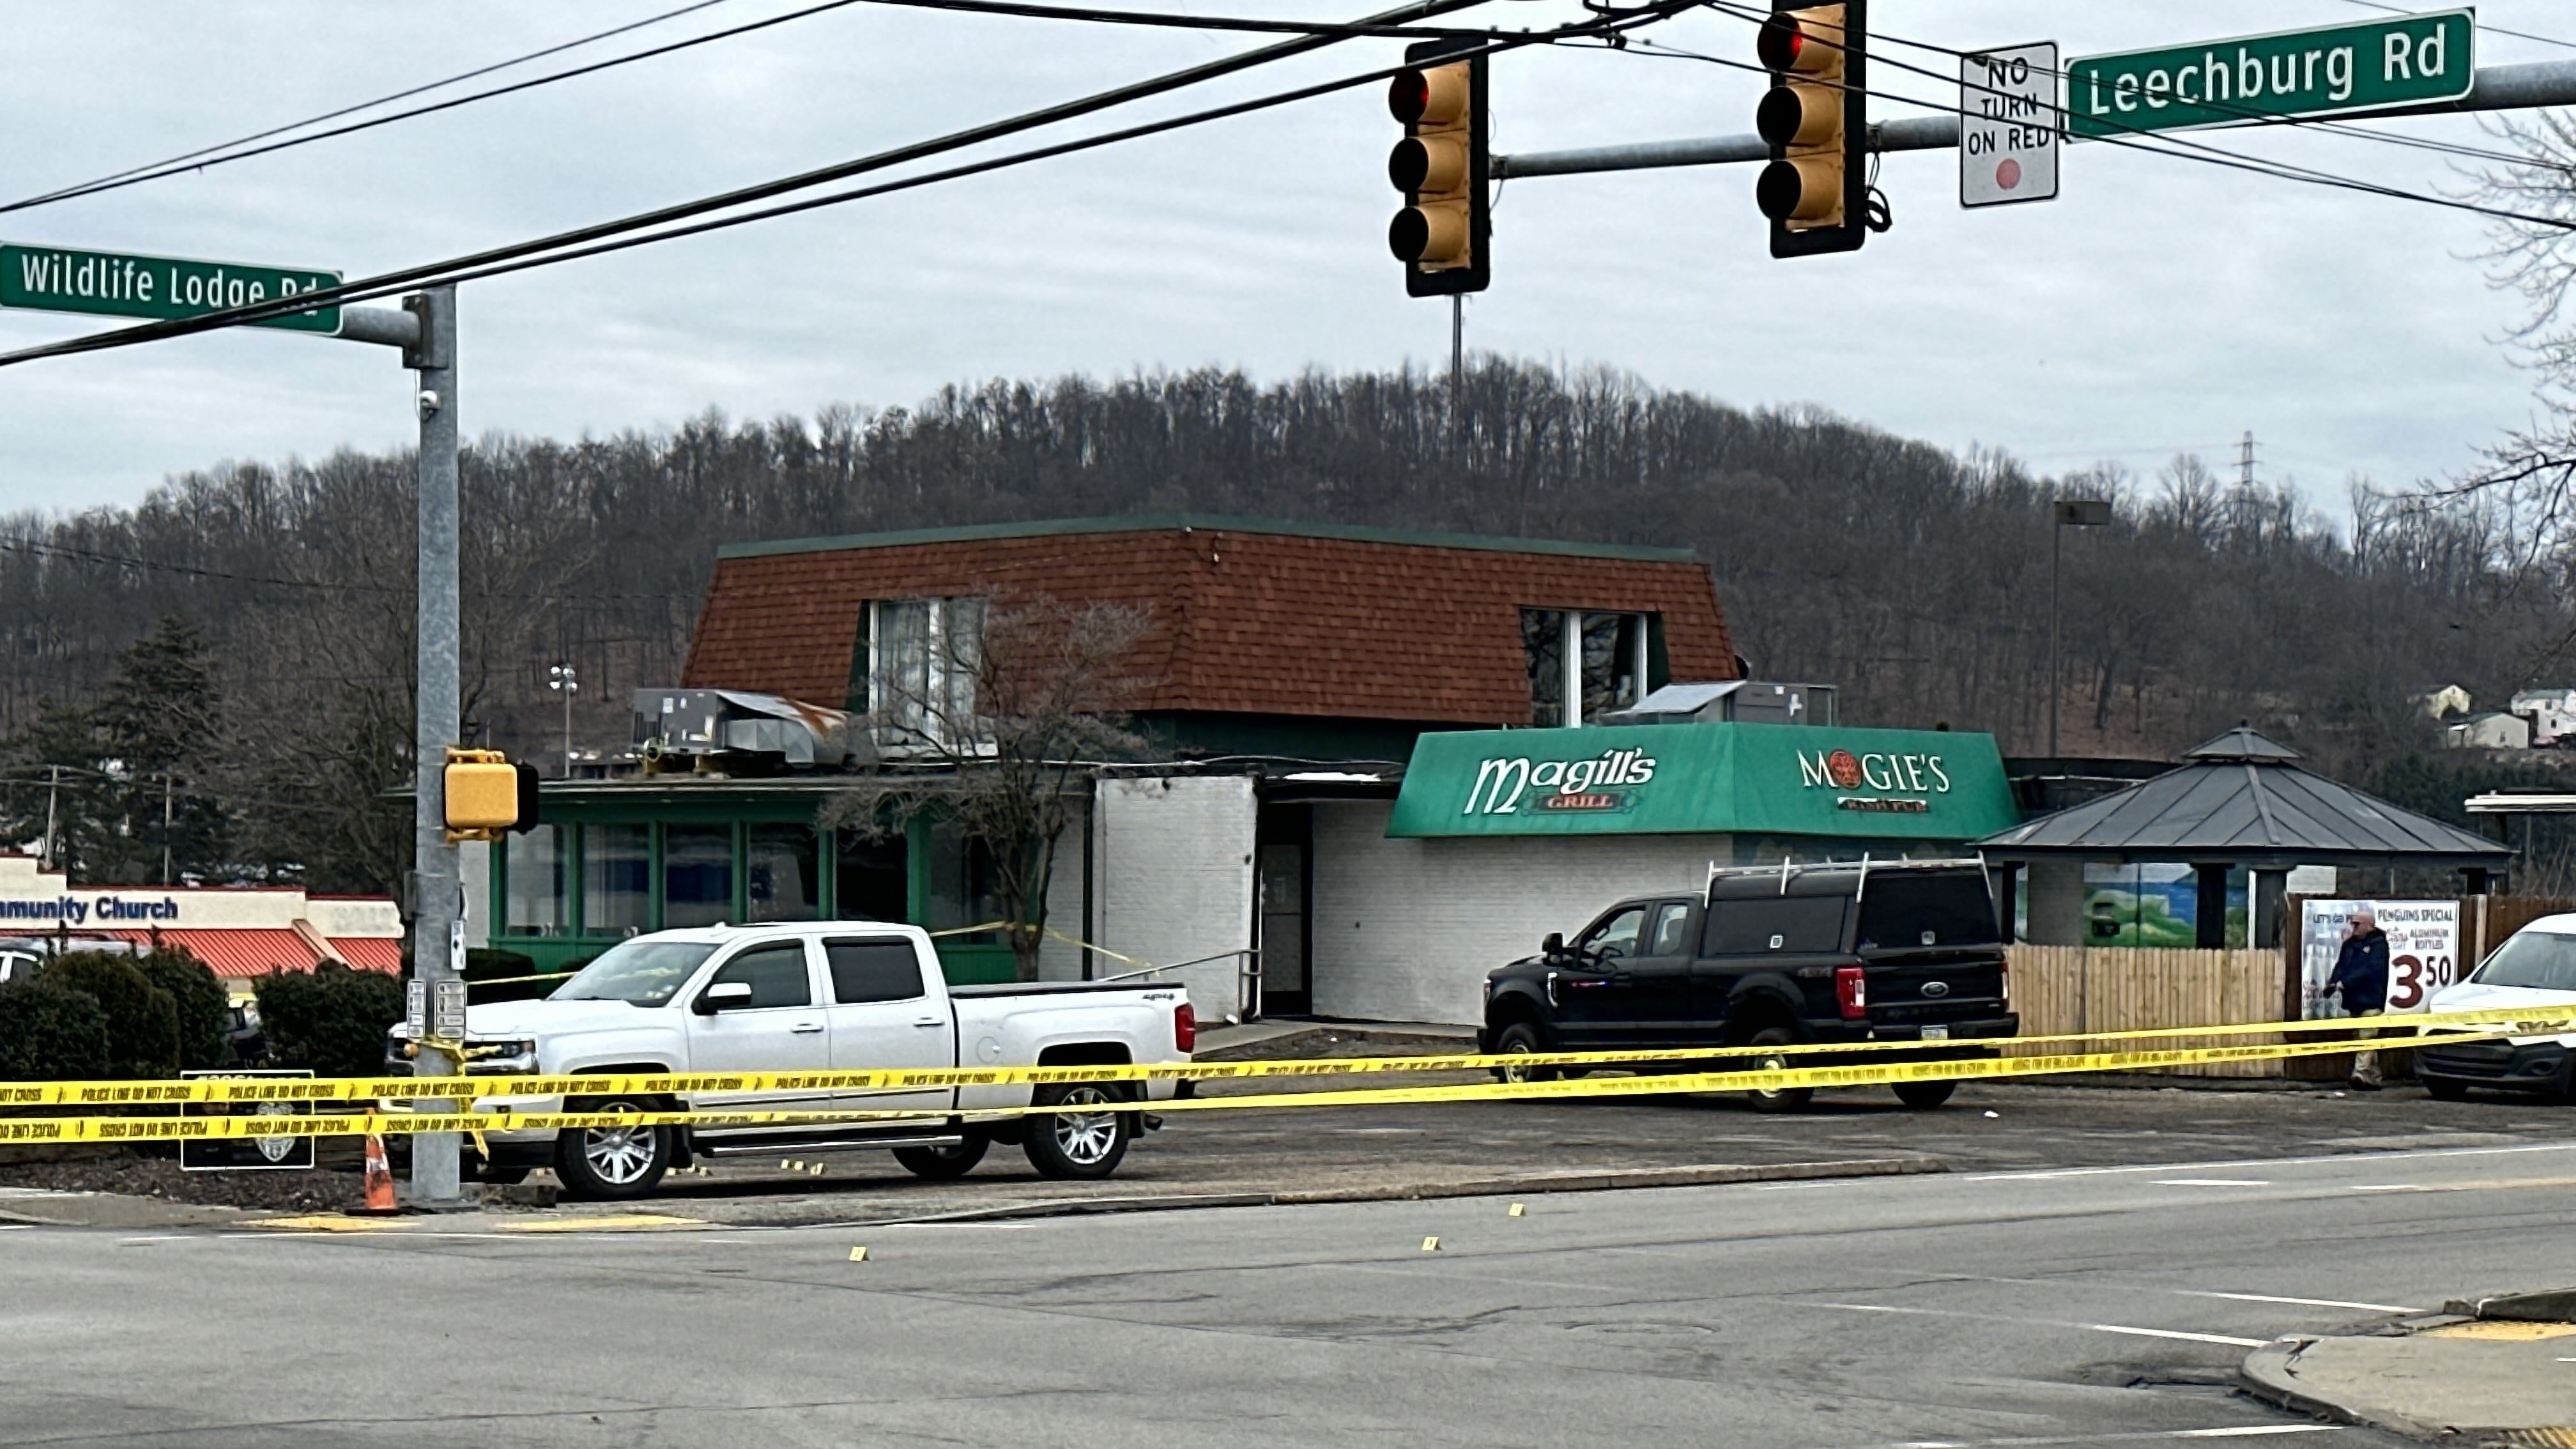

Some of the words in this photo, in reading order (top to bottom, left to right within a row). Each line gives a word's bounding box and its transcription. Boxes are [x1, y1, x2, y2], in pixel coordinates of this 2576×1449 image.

[1989, 57, 2028, 88] NO
[2090, 46, 2354, 116] Leechburg
[2384, 23, 2446, 82] Rd
[1981, 93, 2037, 118] TURN
[1968, 130, 1995, 155] ON
[2009, 127, 2049, 151] RED
[22, 254, 153, 302] Wildlife
[1462, 747, 1656, 814] Magill's
[1796, 749, 1950, 793] MOGIE'S
[1547, 795, 1613, 808] GRILL
[0, 896, 89, 924] munity
[96, 896, 178, 919] Church
[2378, 909, 2419, 922] PENGUINS
[2421, 910, 2453, 921] SPECIAL
